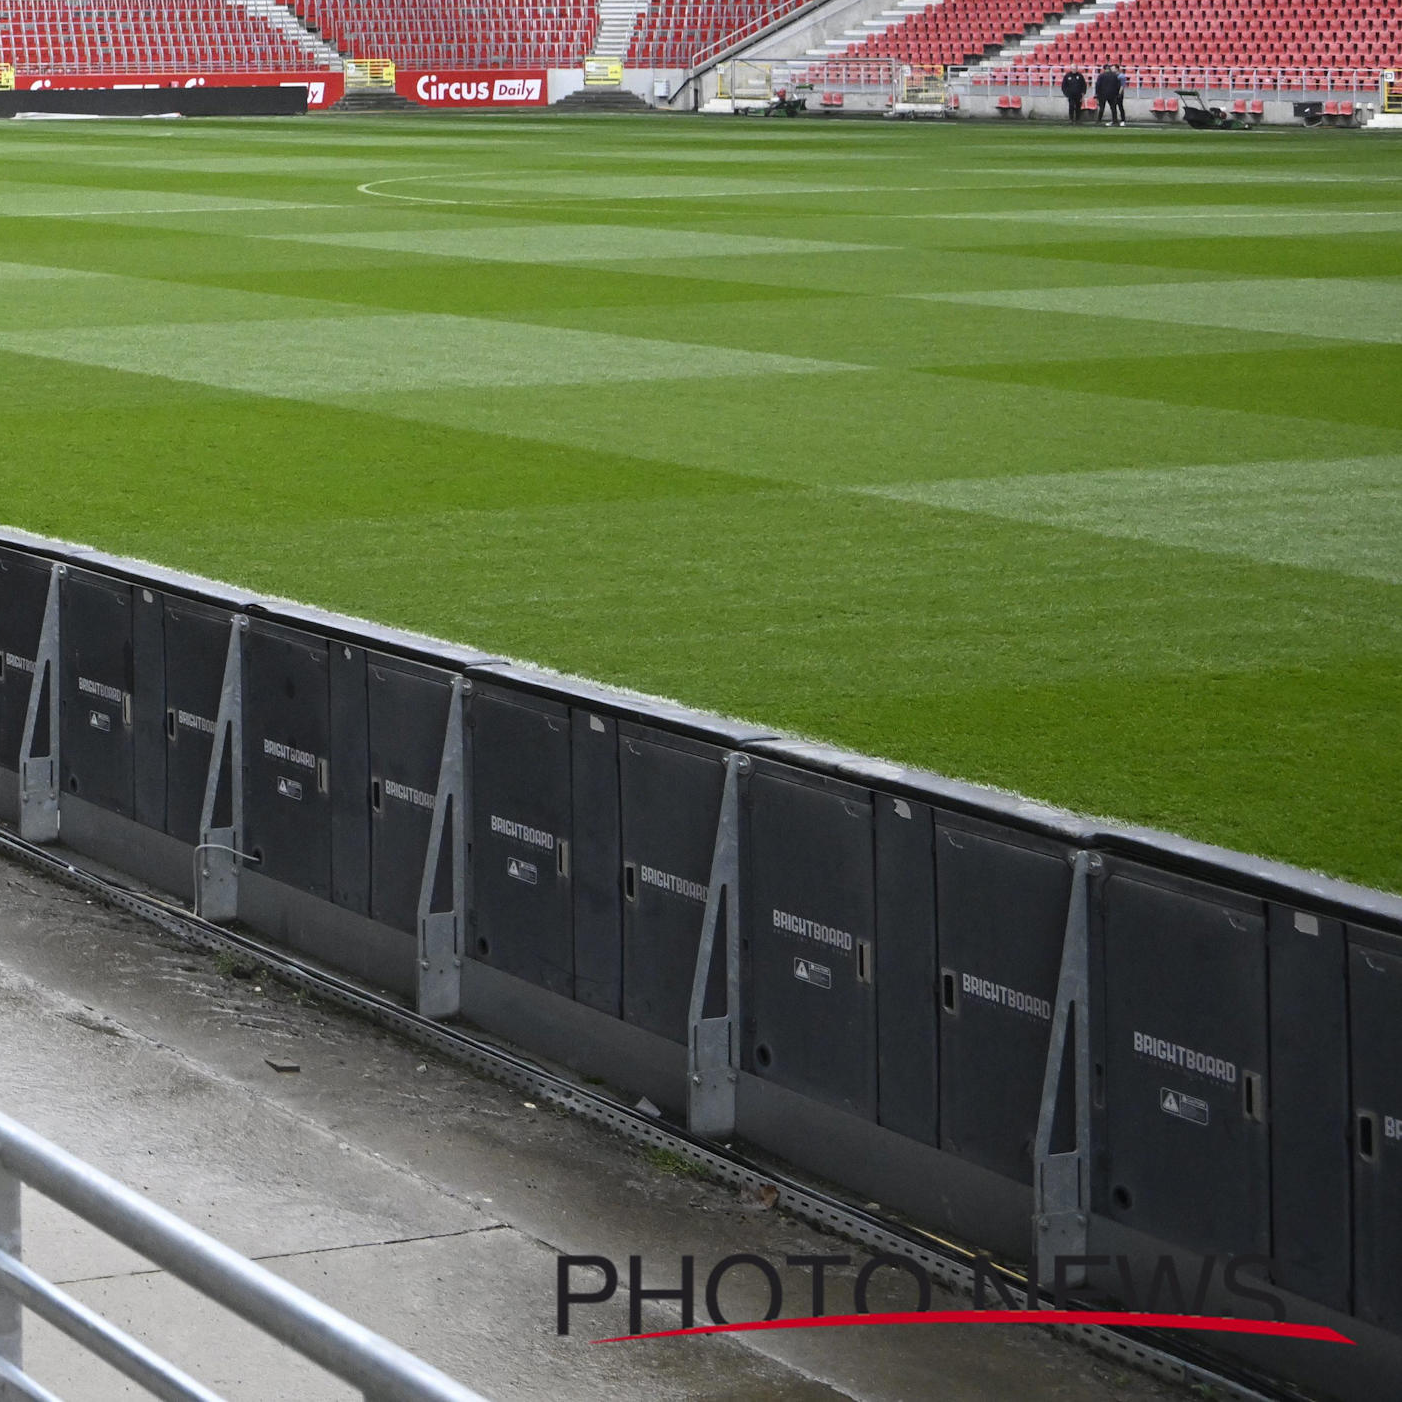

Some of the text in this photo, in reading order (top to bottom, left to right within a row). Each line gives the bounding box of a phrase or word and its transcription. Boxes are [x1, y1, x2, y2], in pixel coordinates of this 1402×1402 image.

[416, 75, 535, 101] Circus Daily
[263, 738, 315, 769] BRIGHTBOARD
[385, 779, 436, 811] BRIGHTBOAR
[491, 814, 553, 850] BRIGHTBOARD
[773, 909, 852, 951] BRIGHTBOARD
[962, 973, 1051, 1021] BRIGHTBOARD
[1133, 1030, 1236, 1084] BRIGHTBOARD
